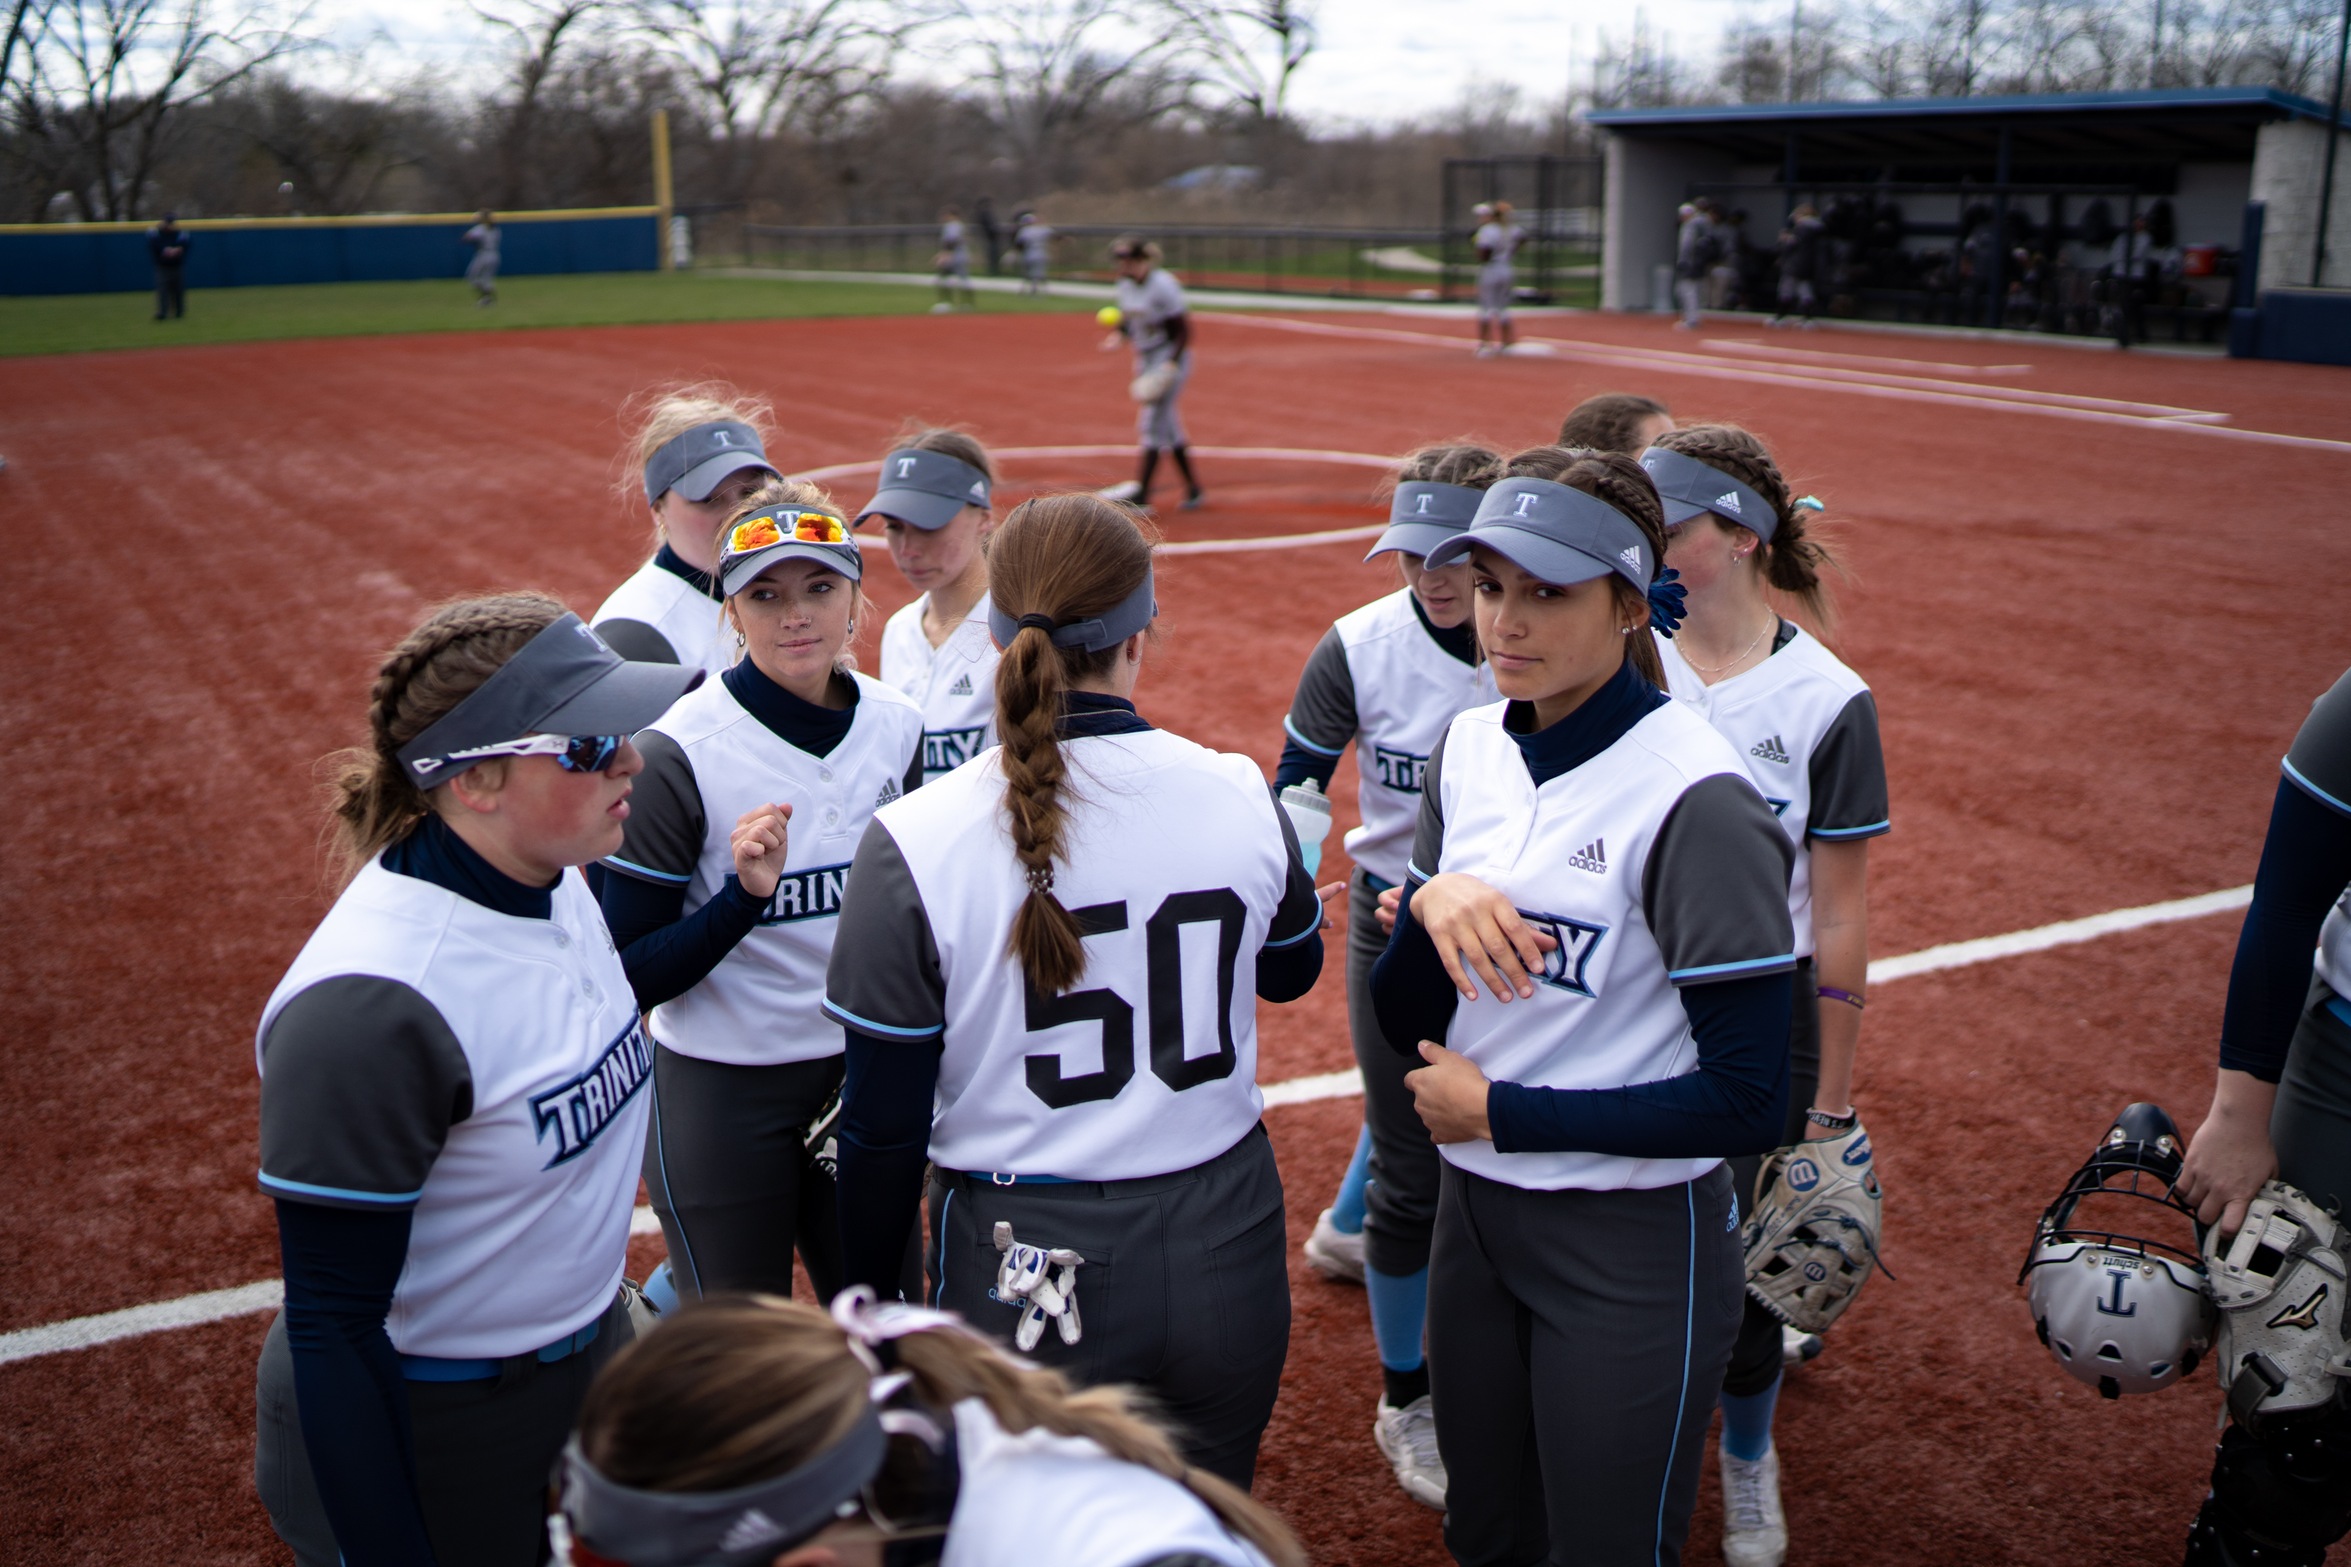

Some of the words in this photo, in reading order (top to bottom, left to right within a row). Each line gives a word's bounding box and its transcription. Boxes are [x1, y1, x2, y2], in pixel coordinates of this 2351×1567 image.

[713, 430, 731, 447] T
[897, 457, 917, 479] T
[1416, 493, 1433, 514] T
[1513, 492, 1538, 518] T
[1715, 498, 1742, 514] adidas
[776, 510, 801, 532] T
[1750, 747, 1790, 764] adidas
[1568, 855, 1608, 875] adidas
[1023, 887, 1247, 1110] 50
[532, 1006, 651, 1164] TRINIT
[2102, 1256, 2140, 1270] schutt
[2096, 1269, 2138, 1318] T
